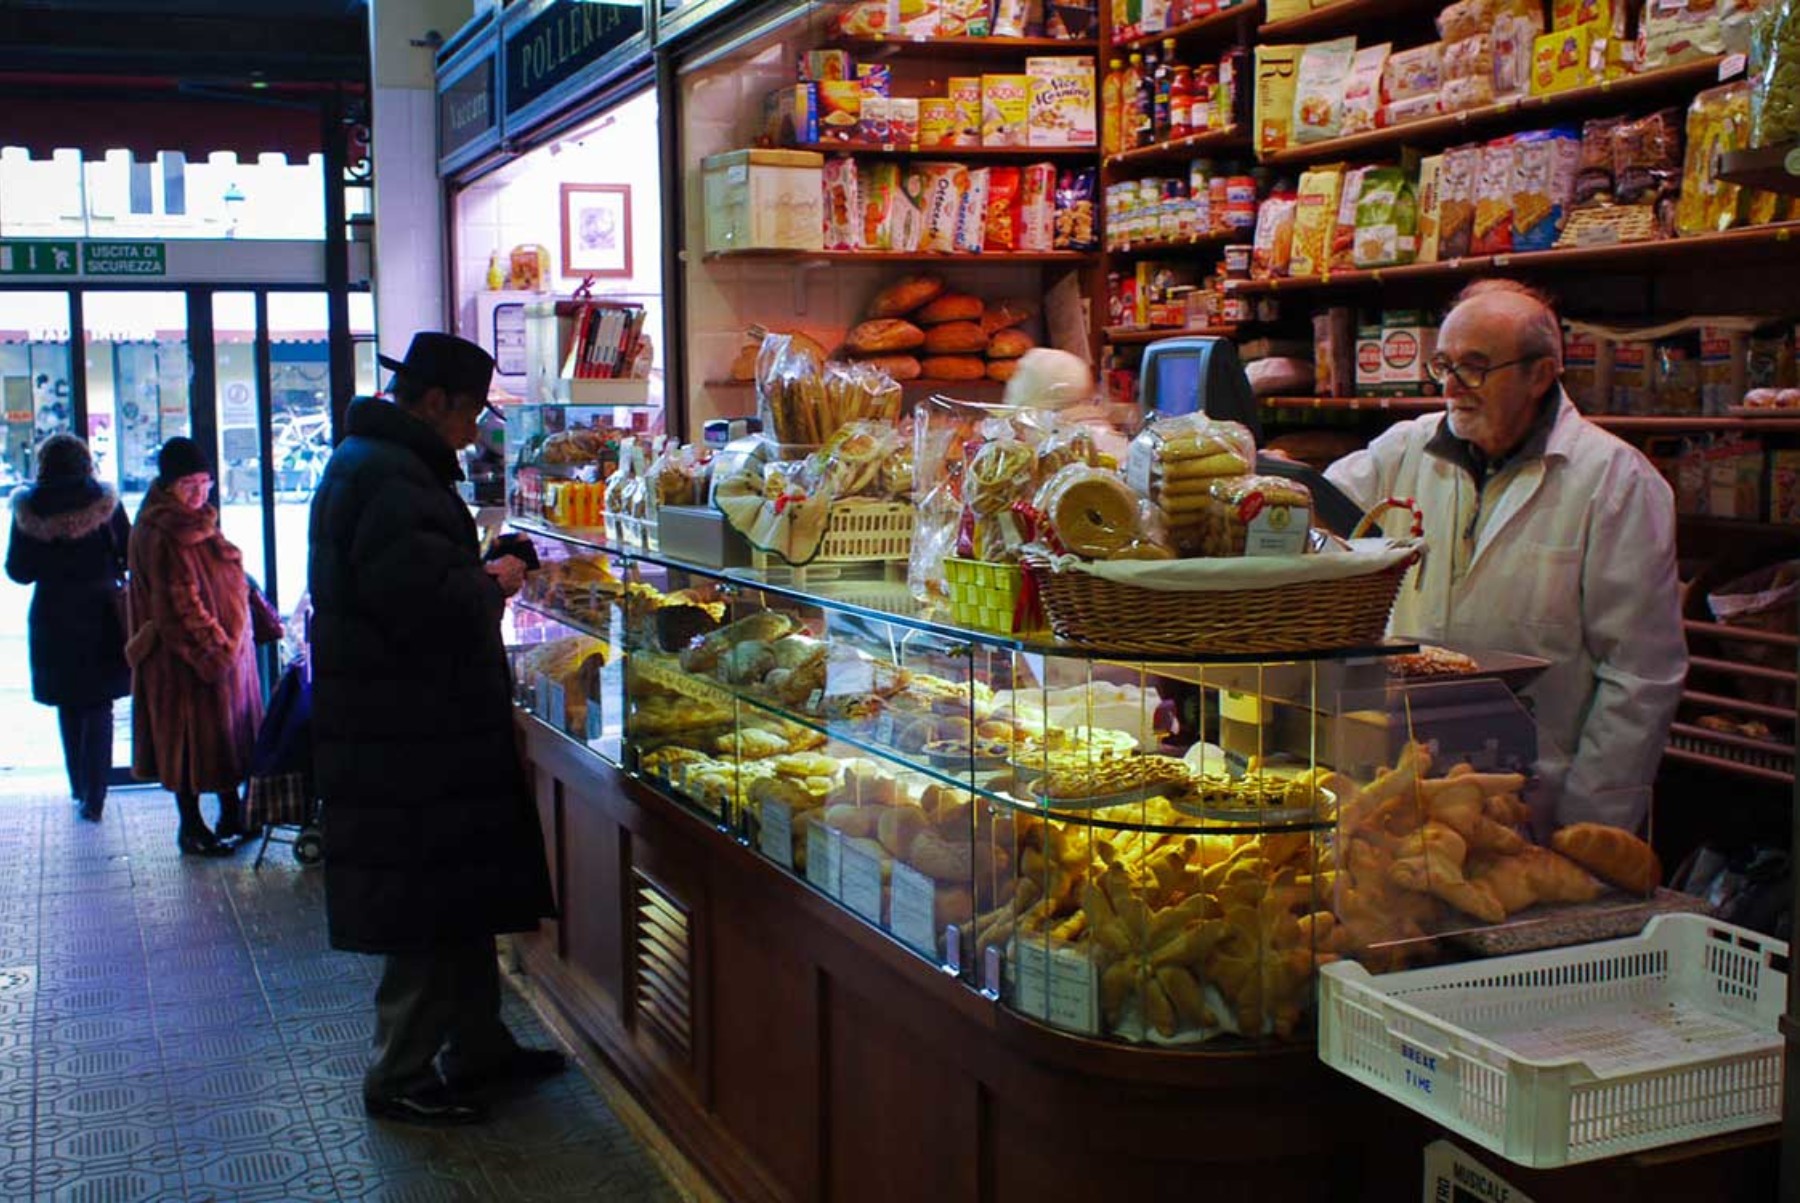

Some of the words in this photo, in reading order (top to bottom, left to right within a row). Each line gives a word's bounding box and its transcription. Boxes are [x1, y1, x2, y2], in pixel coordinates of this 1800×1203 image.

[522, 3, 621, 89] POLLERIA
[91, 245, 139, 258] USCITA
[143, 245, 158, 258] DI
[86, 260, 162, 272] SICUREZZA
[1405, 1068, 1432, 1093] TIME
